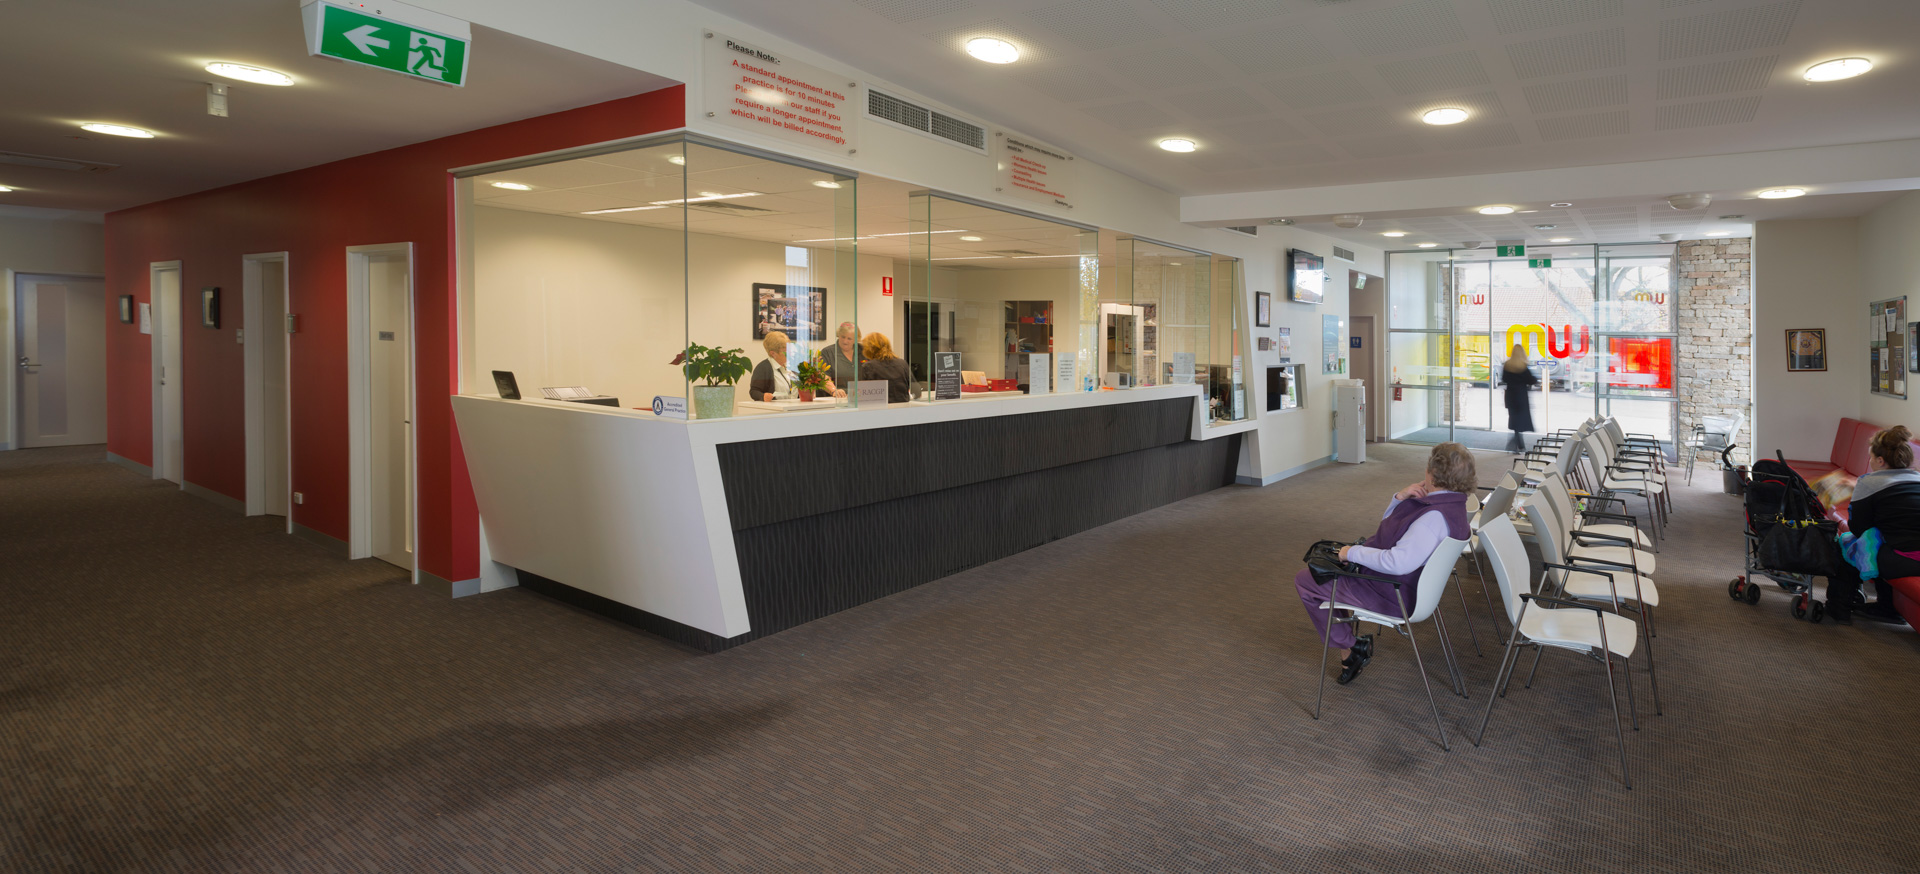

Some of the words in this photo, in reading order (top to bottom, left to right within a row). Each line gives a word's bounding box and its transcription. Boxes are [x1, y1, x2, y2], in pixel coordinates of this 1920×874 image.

[727, 40, 754, 55] Please
[732, 59, 739, 67] A
[741, 62, 776, 79] standard
[778, 75, 823, 94] appointment
[833, 92, 845, 101] this
[743, 75, 775, 90] practice
[777, 85, 783, 93] is
[785, 88, 796, 96] for
[808, 96, 835, 109] minutes
[731, 108, 756, 120] which
[757, 115, 771, 124] will
[773, 118, 783, 127] be
[784, 121, 804, 132] billed
[806, 128, 847, 145] accordingly.
[736, 98, 764, 111] require
[773, 107, 796, 119] longer
[799, 115, 843, 133] appointment,
[791, 102, 803, 110] our
[805, 106, 821, 115] staff
[828, 113, 841, 122] you
[862, 388, 885, 396] RACGP
